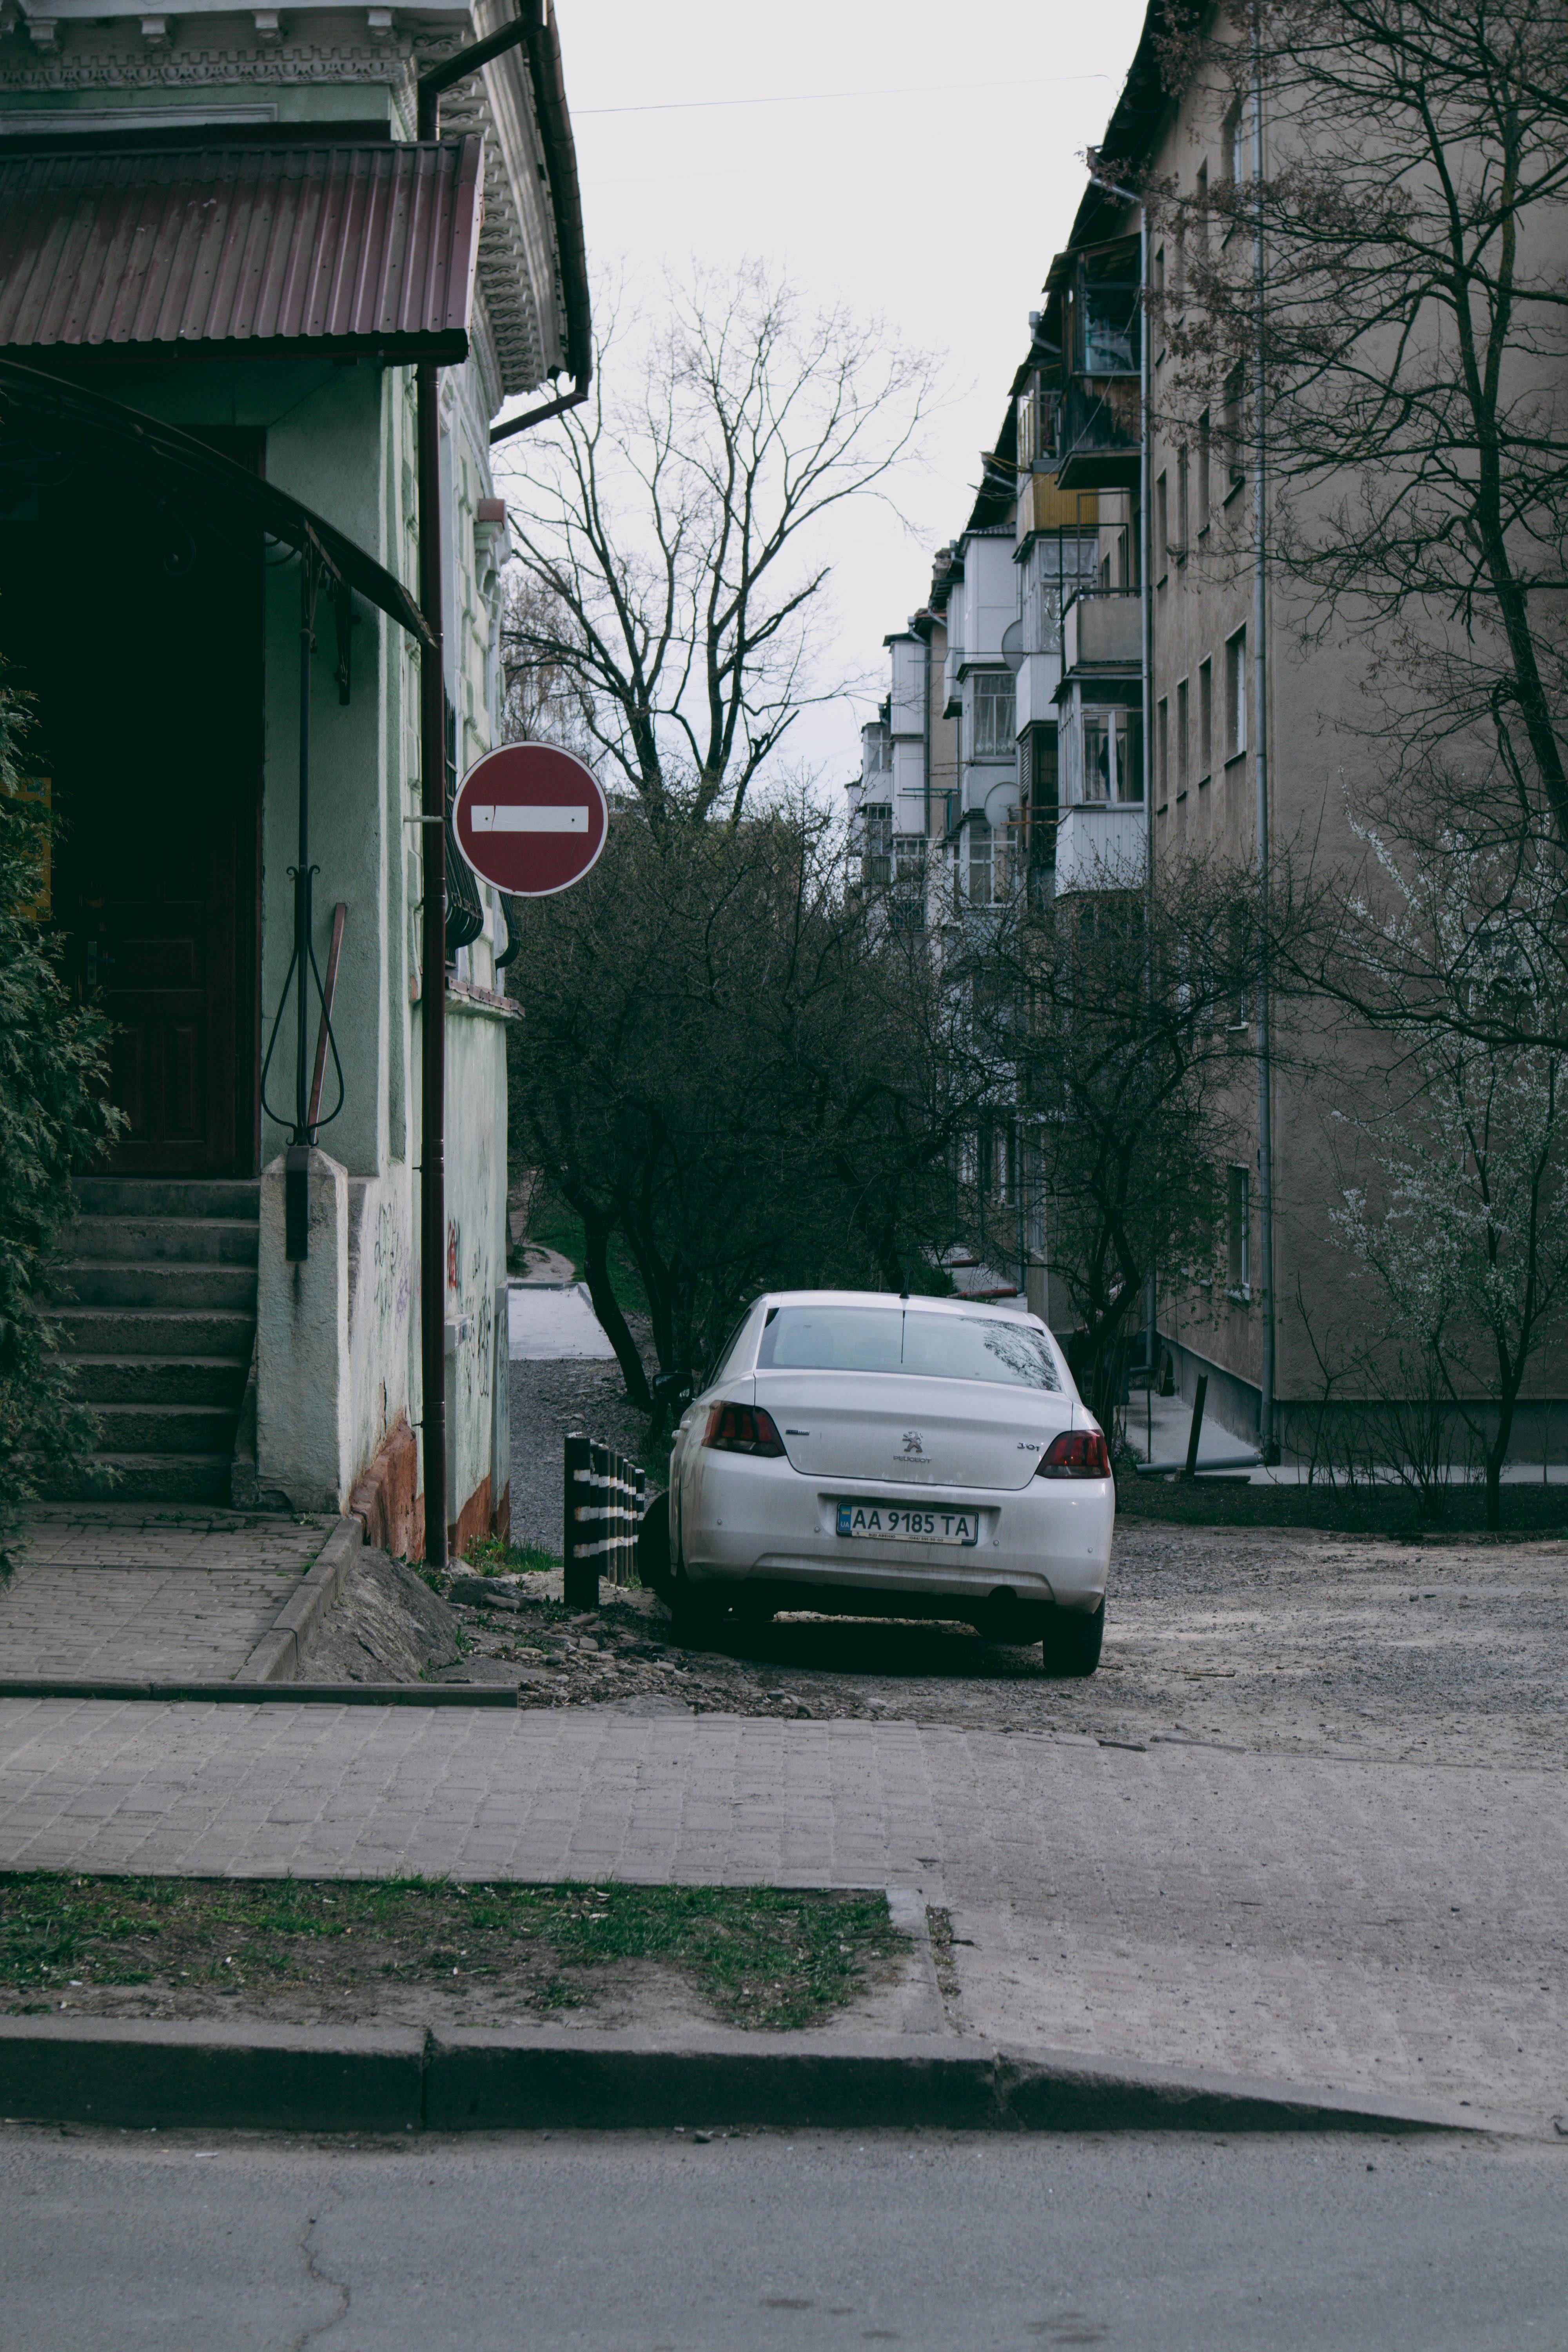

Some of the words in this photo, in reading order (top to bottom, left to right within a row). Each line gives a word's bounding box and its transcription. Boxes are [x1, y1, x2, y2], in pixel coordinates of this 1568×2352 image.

[1017, 1443, 1040, 1452] 301
[893, 1455, 931, 1463] PEUGEOT
[852, 1510, 881, 1530] AA
[888, 1512, 934, 1534] 9185
[941, 1515, 969, 1537] TA
